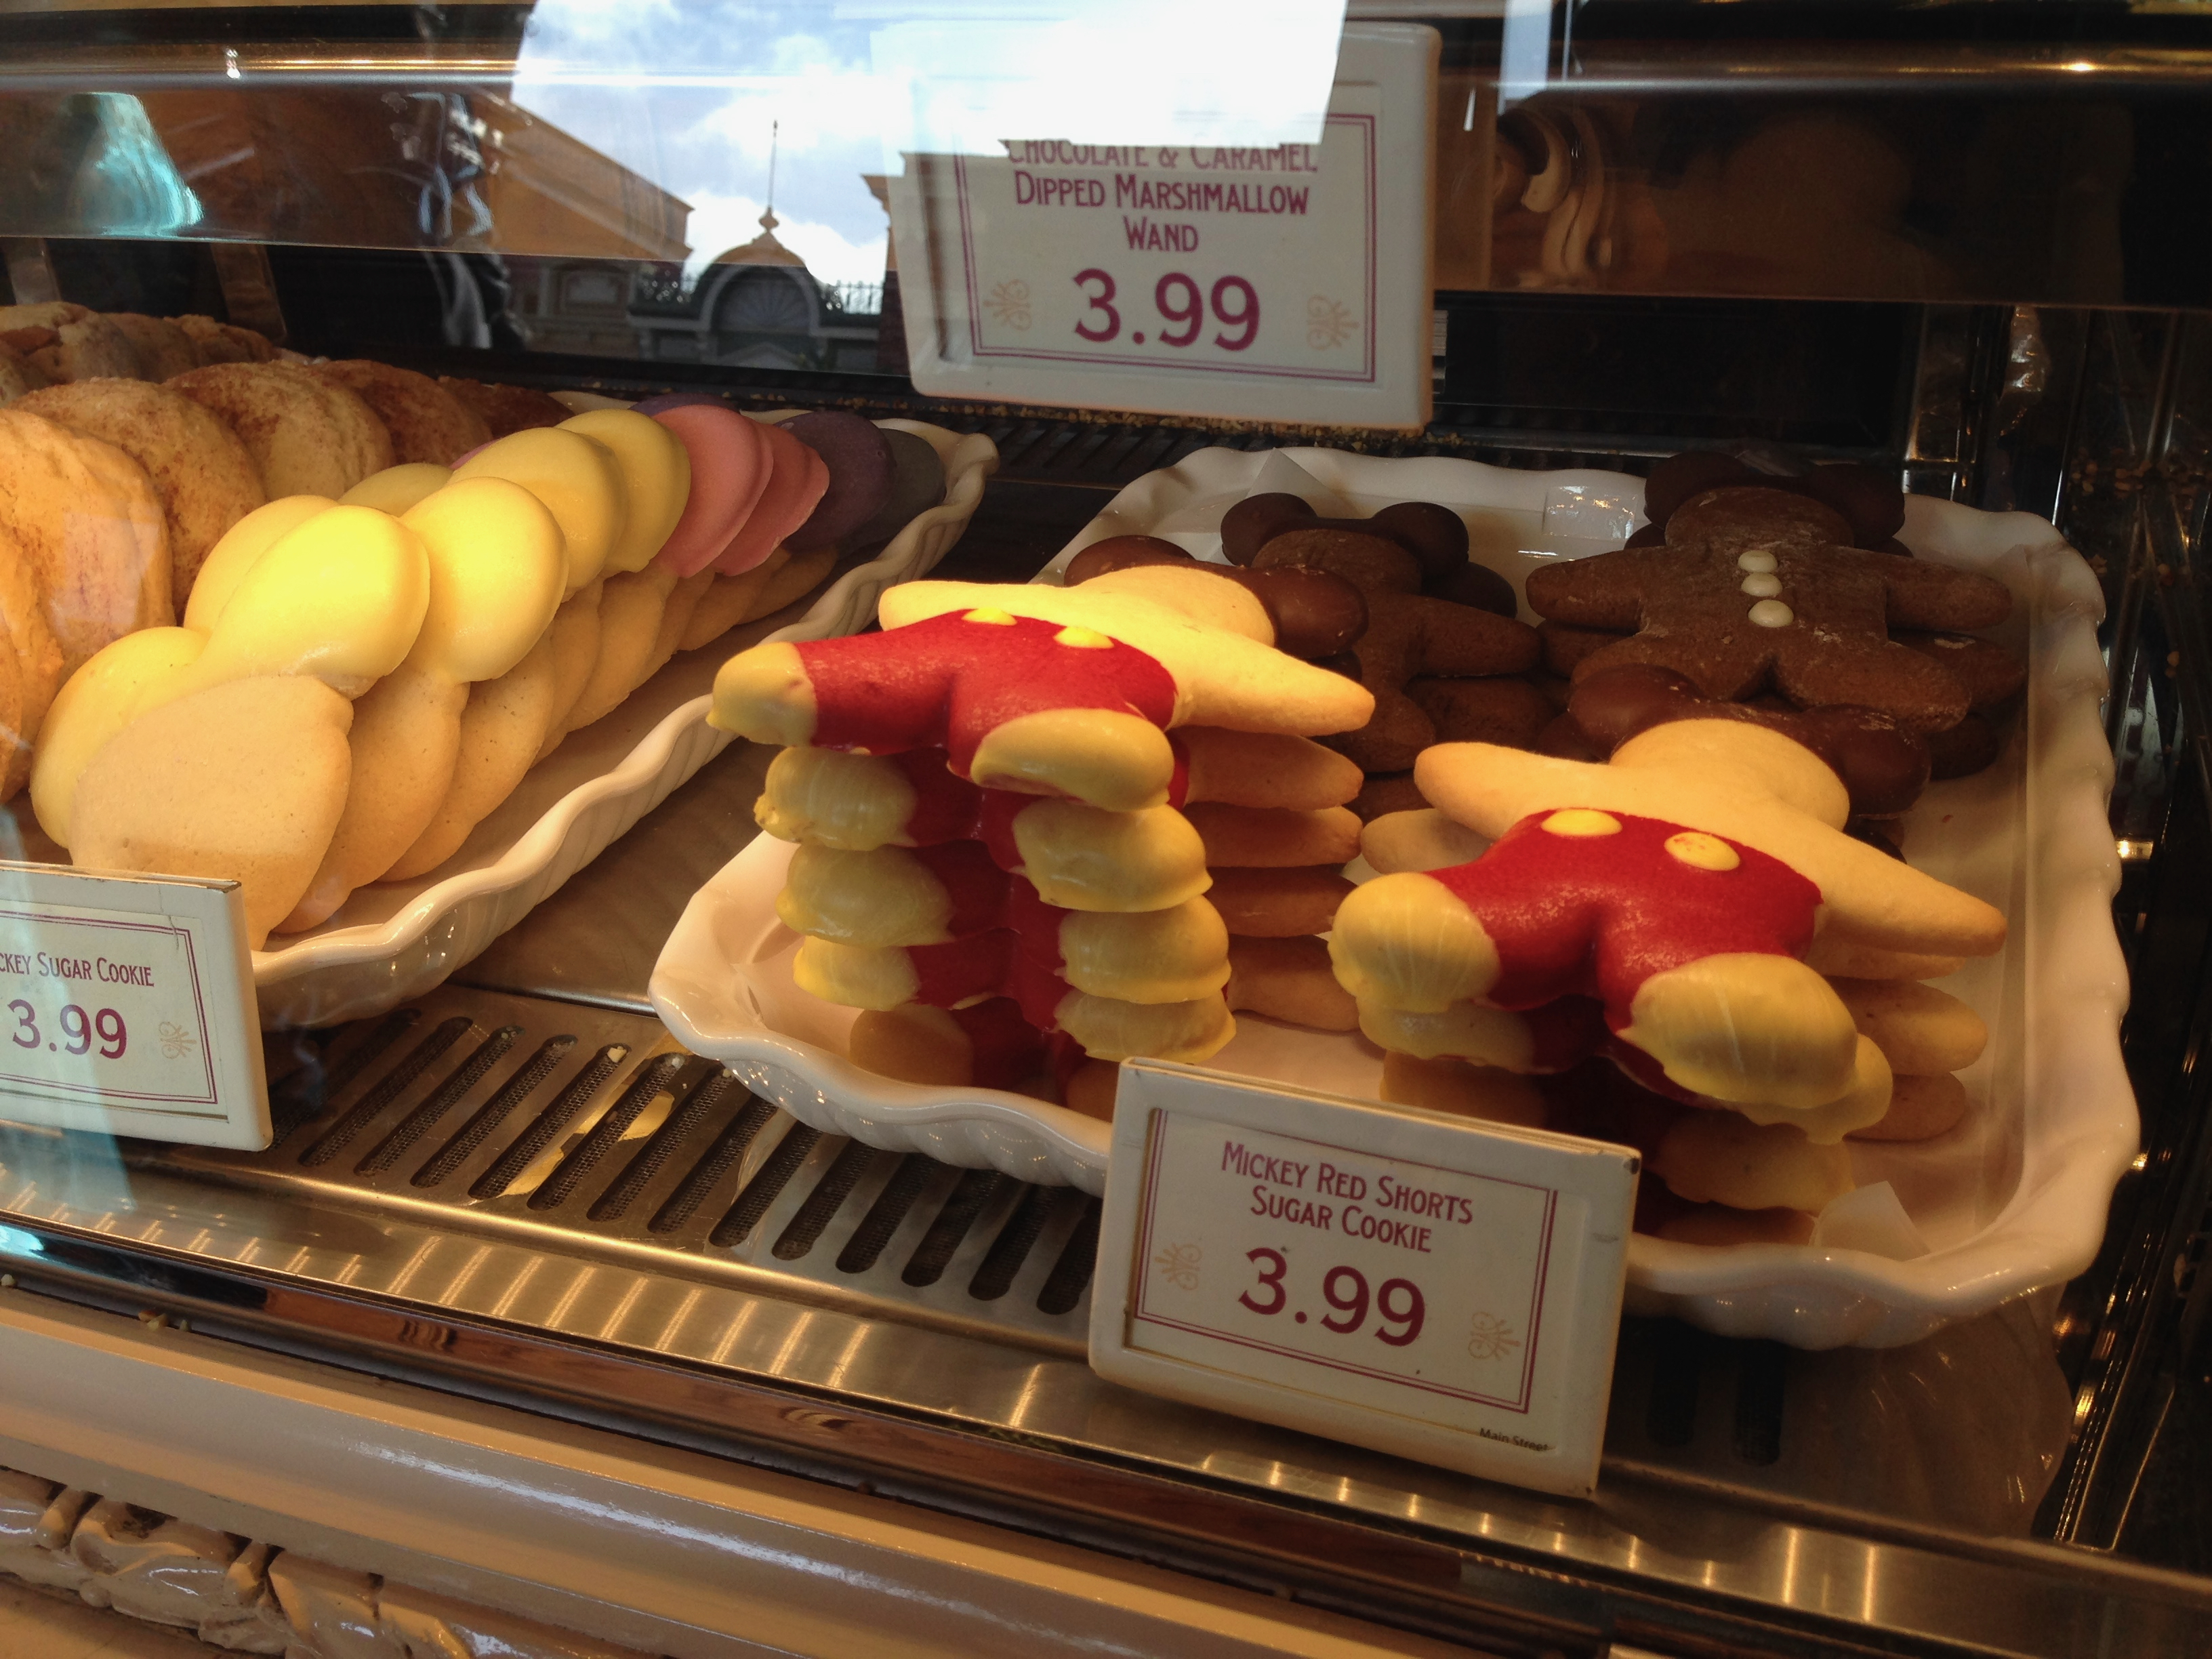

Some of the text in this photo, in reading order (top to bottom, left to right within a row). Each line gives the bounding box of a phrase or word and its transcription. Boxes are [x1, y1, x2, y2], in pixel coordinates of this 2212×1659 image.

[1008, 140, 1319, 173] CHOCOLATE & CARAMEL
[1013, 169, 1309, 216] DIPPED MARSHMALLOW
[1123, 216, 1199, 252] WAND
[1073, 268, 1261, 352] 3.99
[37, 951, 92, 981] SUGAR
[96, 957, 155, 987] COOKIE
[7, 998, 127, 1059] 3.99
[1221, 1141, 1473, 1224] MICKEY RED SHORTS
[1250, 1185, 1431, 1253] SUGAR COOKIE
[1238, 1247, 1426, 1347] 3.99
[1479, 1427, 1549, 1451] Main Street
